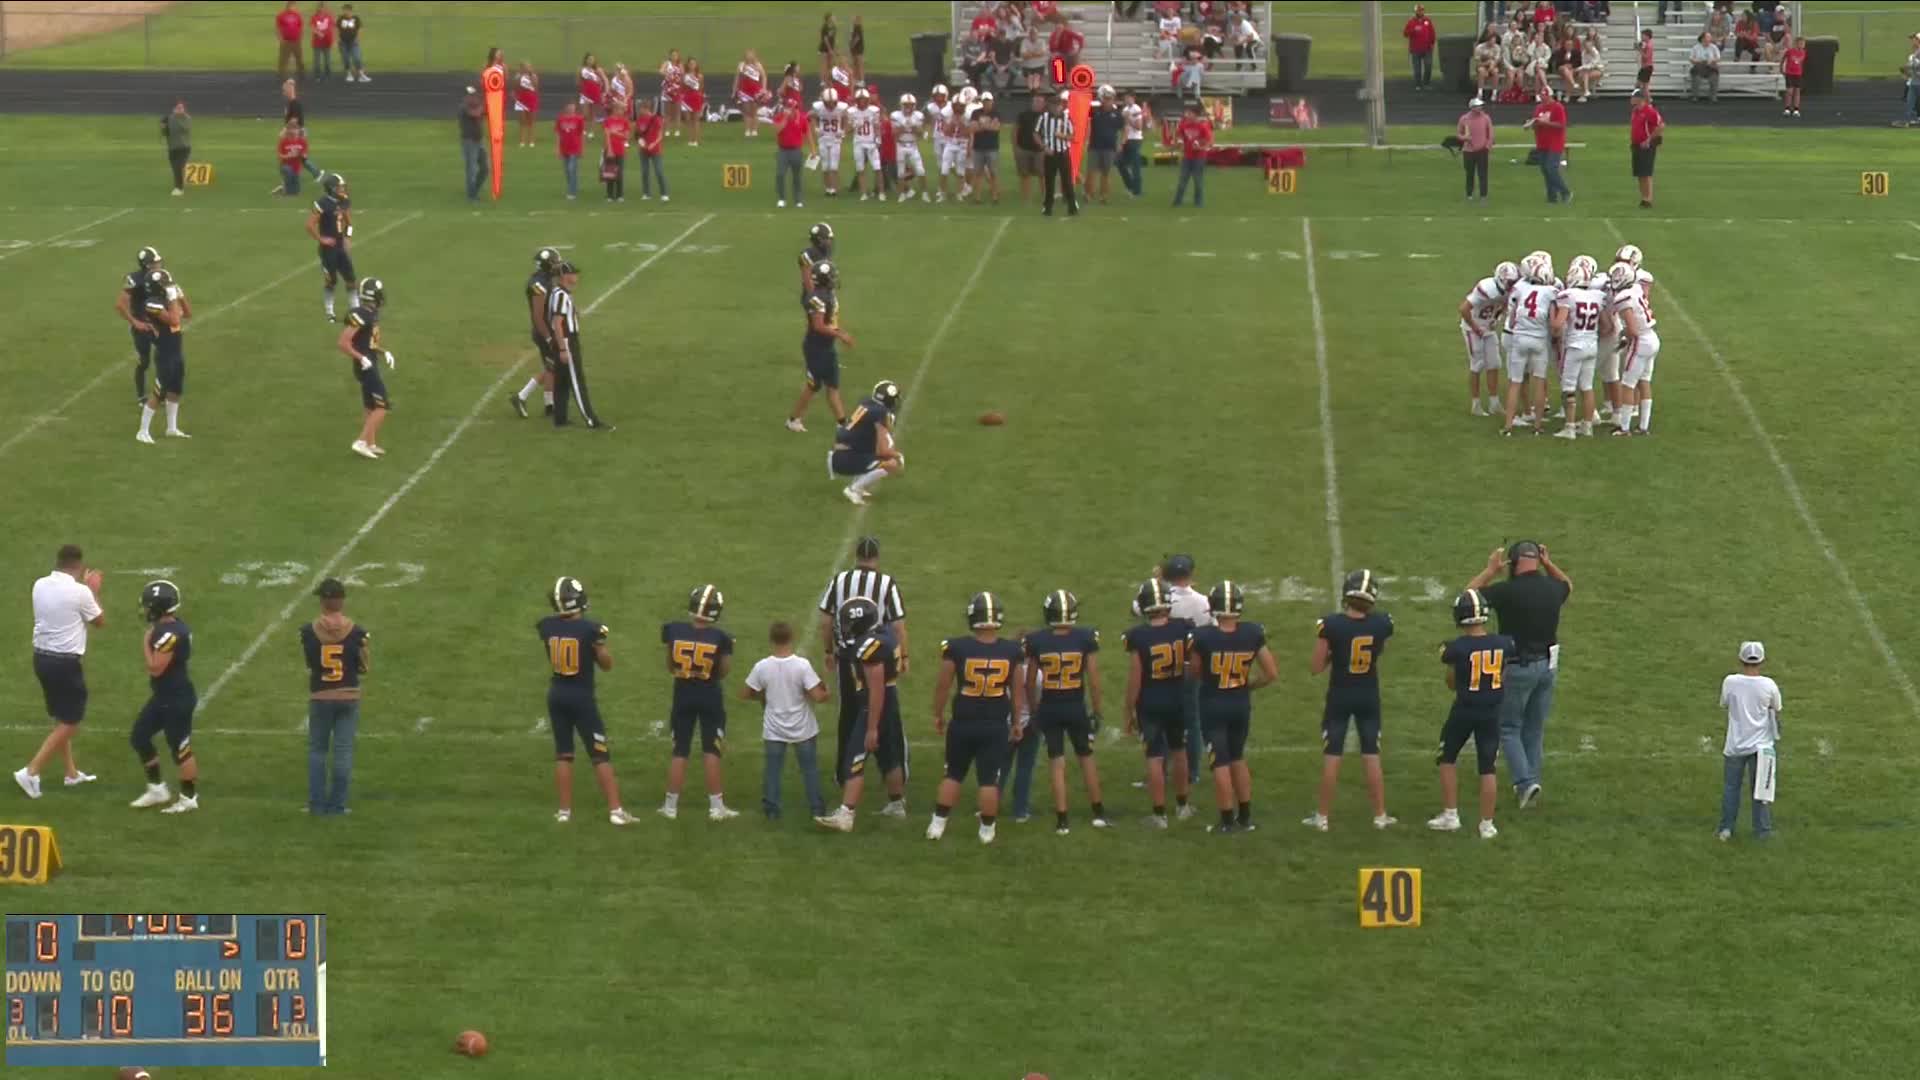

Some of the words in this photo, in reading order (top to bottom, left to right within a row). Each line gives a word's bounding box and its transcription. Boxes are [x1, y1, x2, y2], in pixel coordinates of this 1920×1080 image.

[1053, 59, 1064, 82] 1
[187, 165, 207, 183] 20
[728, 166, 747, 186] 30
[1270, 171, 1291, 192] 40
[1864, 173, 1885, 194] 30
[1524, 290, 1538, 318] 4
[1574, 302, 1600, 331] 52
[848, 607, 864, 619] 30
[320, 644, 344, 682] 5
[549, 636, 580, 676] 10
[671, 639, 718, 680] 55
[1039, 651, 1083, 690] 22
[1150, 639, 1185, 680] 21
[1210, 651, 1255, 689] 45
[1350, 635, 1374, 674] 6
[1469, 648, 1504, 691] 14
[960, 657, 1010, 697] 52
[0, 826, 40, 879] 30
[1362, 871, 1413, 922] 40
